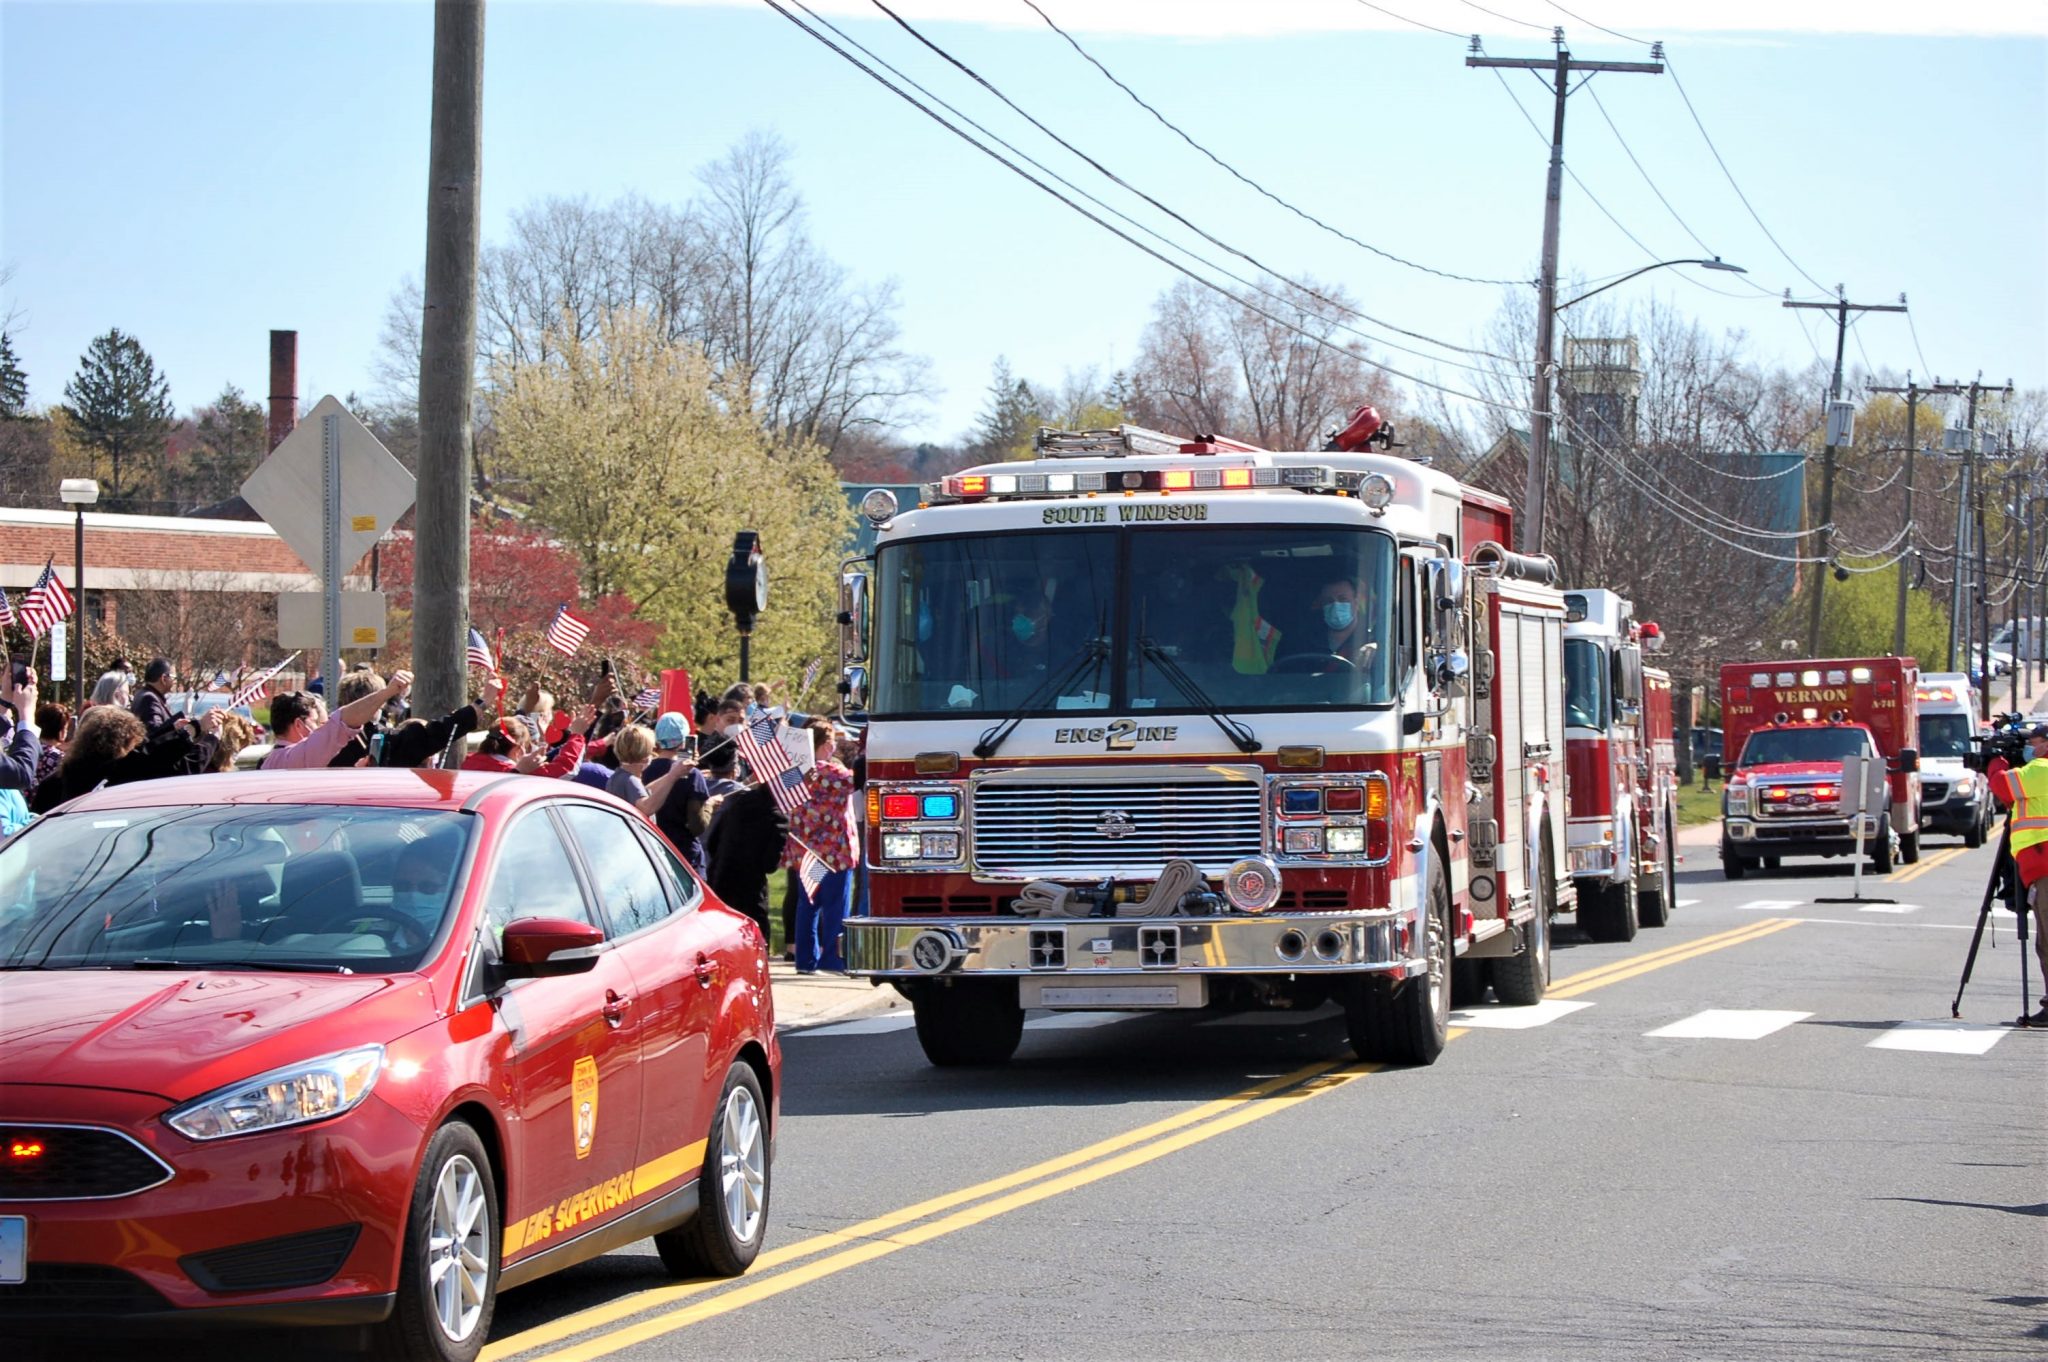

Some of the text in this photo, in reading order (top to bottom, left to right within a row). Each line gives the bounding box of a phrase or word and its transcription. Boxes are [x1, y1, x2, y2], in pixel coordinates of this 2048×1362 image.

[1043, 503, 1208, 524] SOUTH WINDSOR
[1774, 689, 1848, 703] VERNON
[522, 1170, 634, 1248] EMS SUPERVISOR
